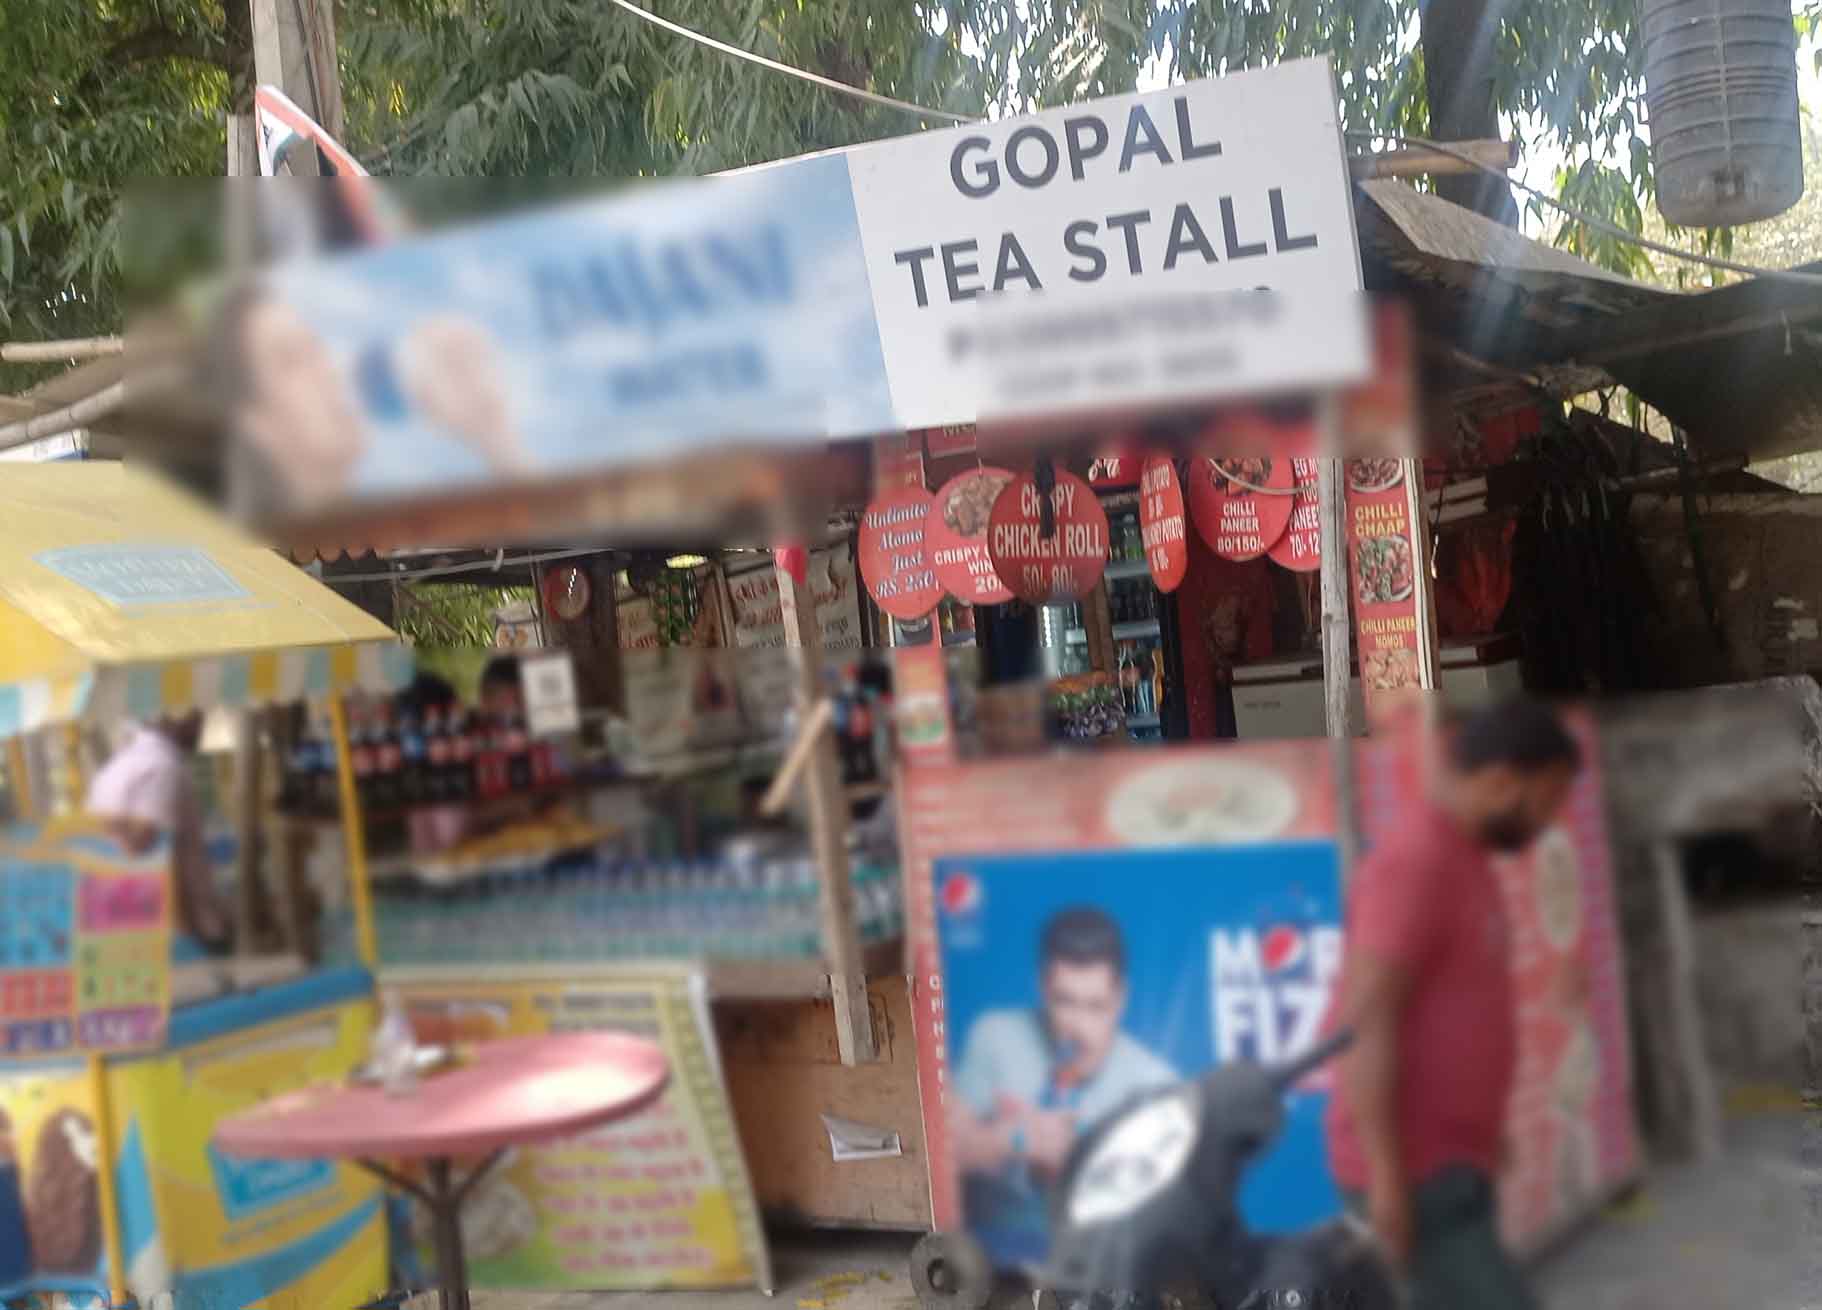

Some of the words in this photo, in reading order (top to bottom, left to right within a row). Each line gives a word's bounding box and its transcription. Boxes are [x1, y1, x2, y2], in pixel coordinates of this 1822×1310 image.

[950, 96, 1222, 198] GOPAL
[894, 231, 1043, 307] TEA
[1064, 188, 1317, 282] STALL
[1223, 501, 1255, 517] CHILLI
[1355, 504, 1403, 521] CHILLI
[1356, 519, 1405, 537] CHAAP
[1066, 523, 1103, 557] ROLL
[935, 546, 979, 566] CRISPY
